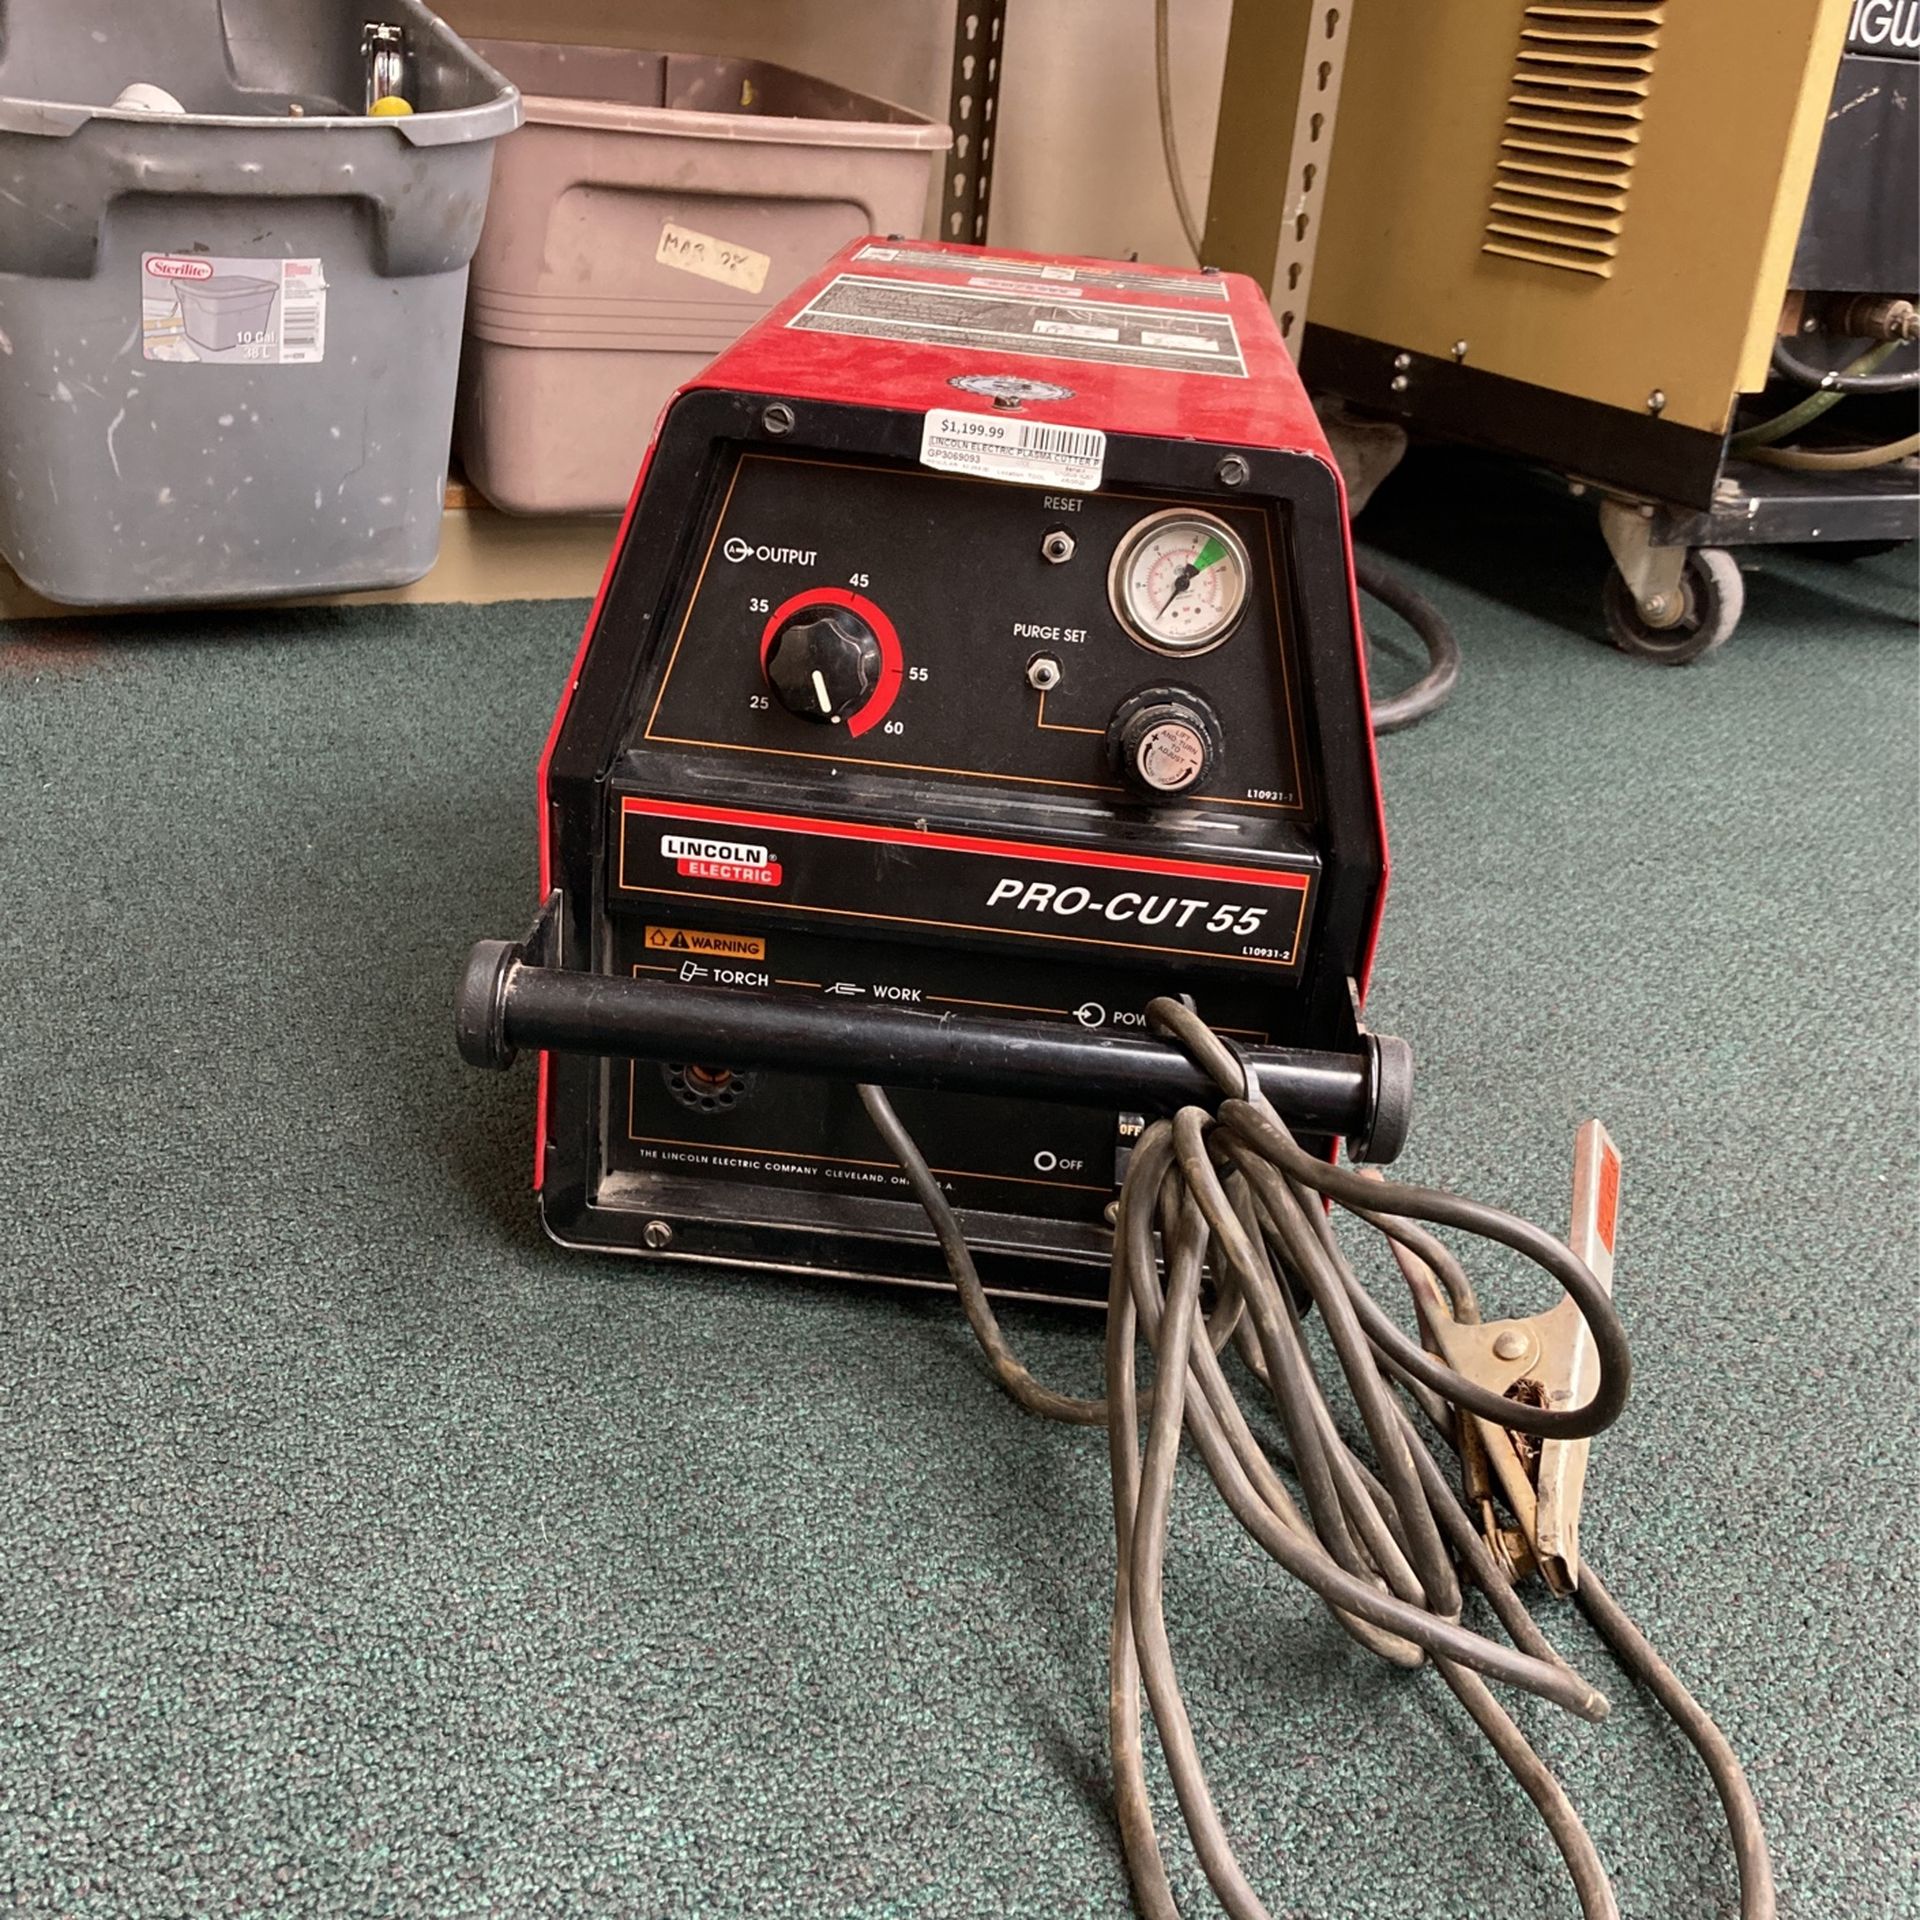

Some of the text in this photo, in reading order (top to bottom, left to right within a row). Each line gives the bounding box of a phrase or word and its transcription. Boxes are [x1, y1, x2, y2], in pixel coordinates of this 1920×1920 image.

[154, 261, 206, 278] Sterilite
[237, 331, 251, 343] 10
[244, 347, 259, 359] 38
[263, 348, 271, 358] L
[941, 419, 1005, 440] $1,199.99
[928, 448, 981, 464] GP3069093
[929, 436, 969, 450] LINCOLN
[971, 442, 1014, 457] ELECTRIC
[1017, 448, 1051, 461] PLASMA
[1054, 454, 1092, 466] CUTTER
[1043, 495, 1083, 512] RESET
[756, 546, 817, 566] OUTPUT
[849, 573, 869, 588] 45
[749, 598, 769, 612] 35
[1013, 623, 1087, 643] PURGE SET
[909, 667, 928, 681] 55
[750, 695, 769, 710] 25
[883, 721, 904, 735] 60
[1175, 729, 1191, 741] LIFT
[1161, 729, 1198, 755] AND TURN
[1171, 743, 1181, 753] TO
[1158, 745, 1185, 764] ADJUST
[1247, 788, 1293, 801] L10931-1
[667, 839, 761, 863] LINCOLN
[688, 861, 773, 884] ELECTRIC
[986, 878, 1268, 935] PRO-CUT 55
[691, 935, 760, 955] WARNING
[1242, 946, 1290, 960] L10931-2
[713, 969, 769, 987] TORCH
[873, 985, 922, 1002] WORK
[1113, 1011, 1147, 1027] POW
[1120, 1124, 1142, 1137] OFF
[640, 1149, 657, 1159] THE
[662, 1151, 709, 1164] LINCOLN
[712, 1156, 760, 1170] ELECTRIC
[764, 1162, 818, 1176] COMPANY
[825, 1168, 887, 1184] CLEVELAND,
[1059, 1159, 1083, 1171] OFF
